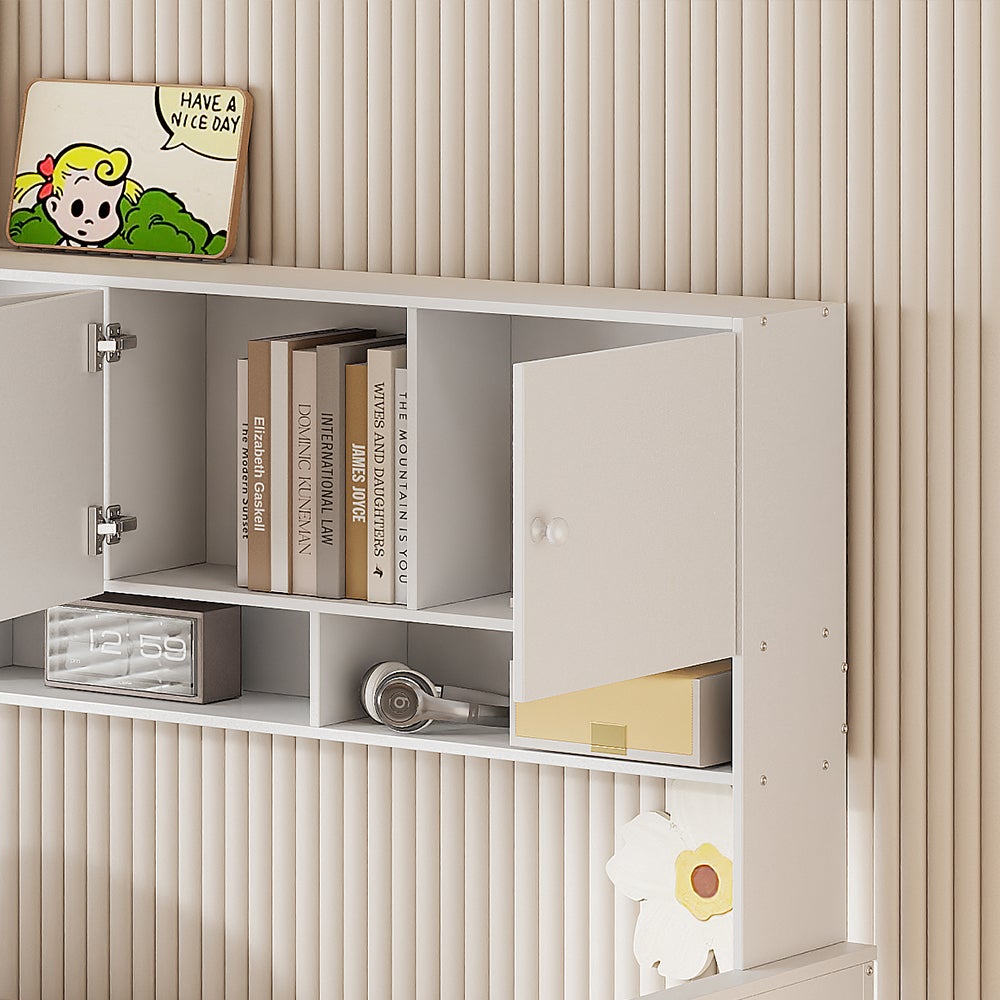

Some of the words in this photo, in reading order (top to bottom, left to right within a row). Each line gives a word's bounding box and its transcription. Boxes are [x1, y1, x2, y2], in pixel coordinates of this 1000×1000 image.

[180, 92, 221, 112] HAVE
[226, 96, 237, 112] A
[171, 111, 208, 130] NICE
[212, 115, 241, 134] DAY
[373, 382, 385, 429] WIVES
[399, 392, 407, 420] THE
[253, 416, 265, 478] Elizabeth
[297, 403, 312, 471] DOMINIC
[374, 432, 385, 464] AND
[320, 412, 334, 514] INTERNATIONAL
[351, 443, 366, 482] JAMES
[398, 429, 407, 521] MOUNTAIN
[253, 481, 265, 532] Gaskell
[297, 475, 312, 555] KUNEMAN
[351, 485, 366, 523] JOYCE
[373, 467, 385, 557] DAUGHTERS
[320, 519, 334, 546] LAW
[398, 528, 407, 542] IS
[398, 549, 407, 584] YOU
